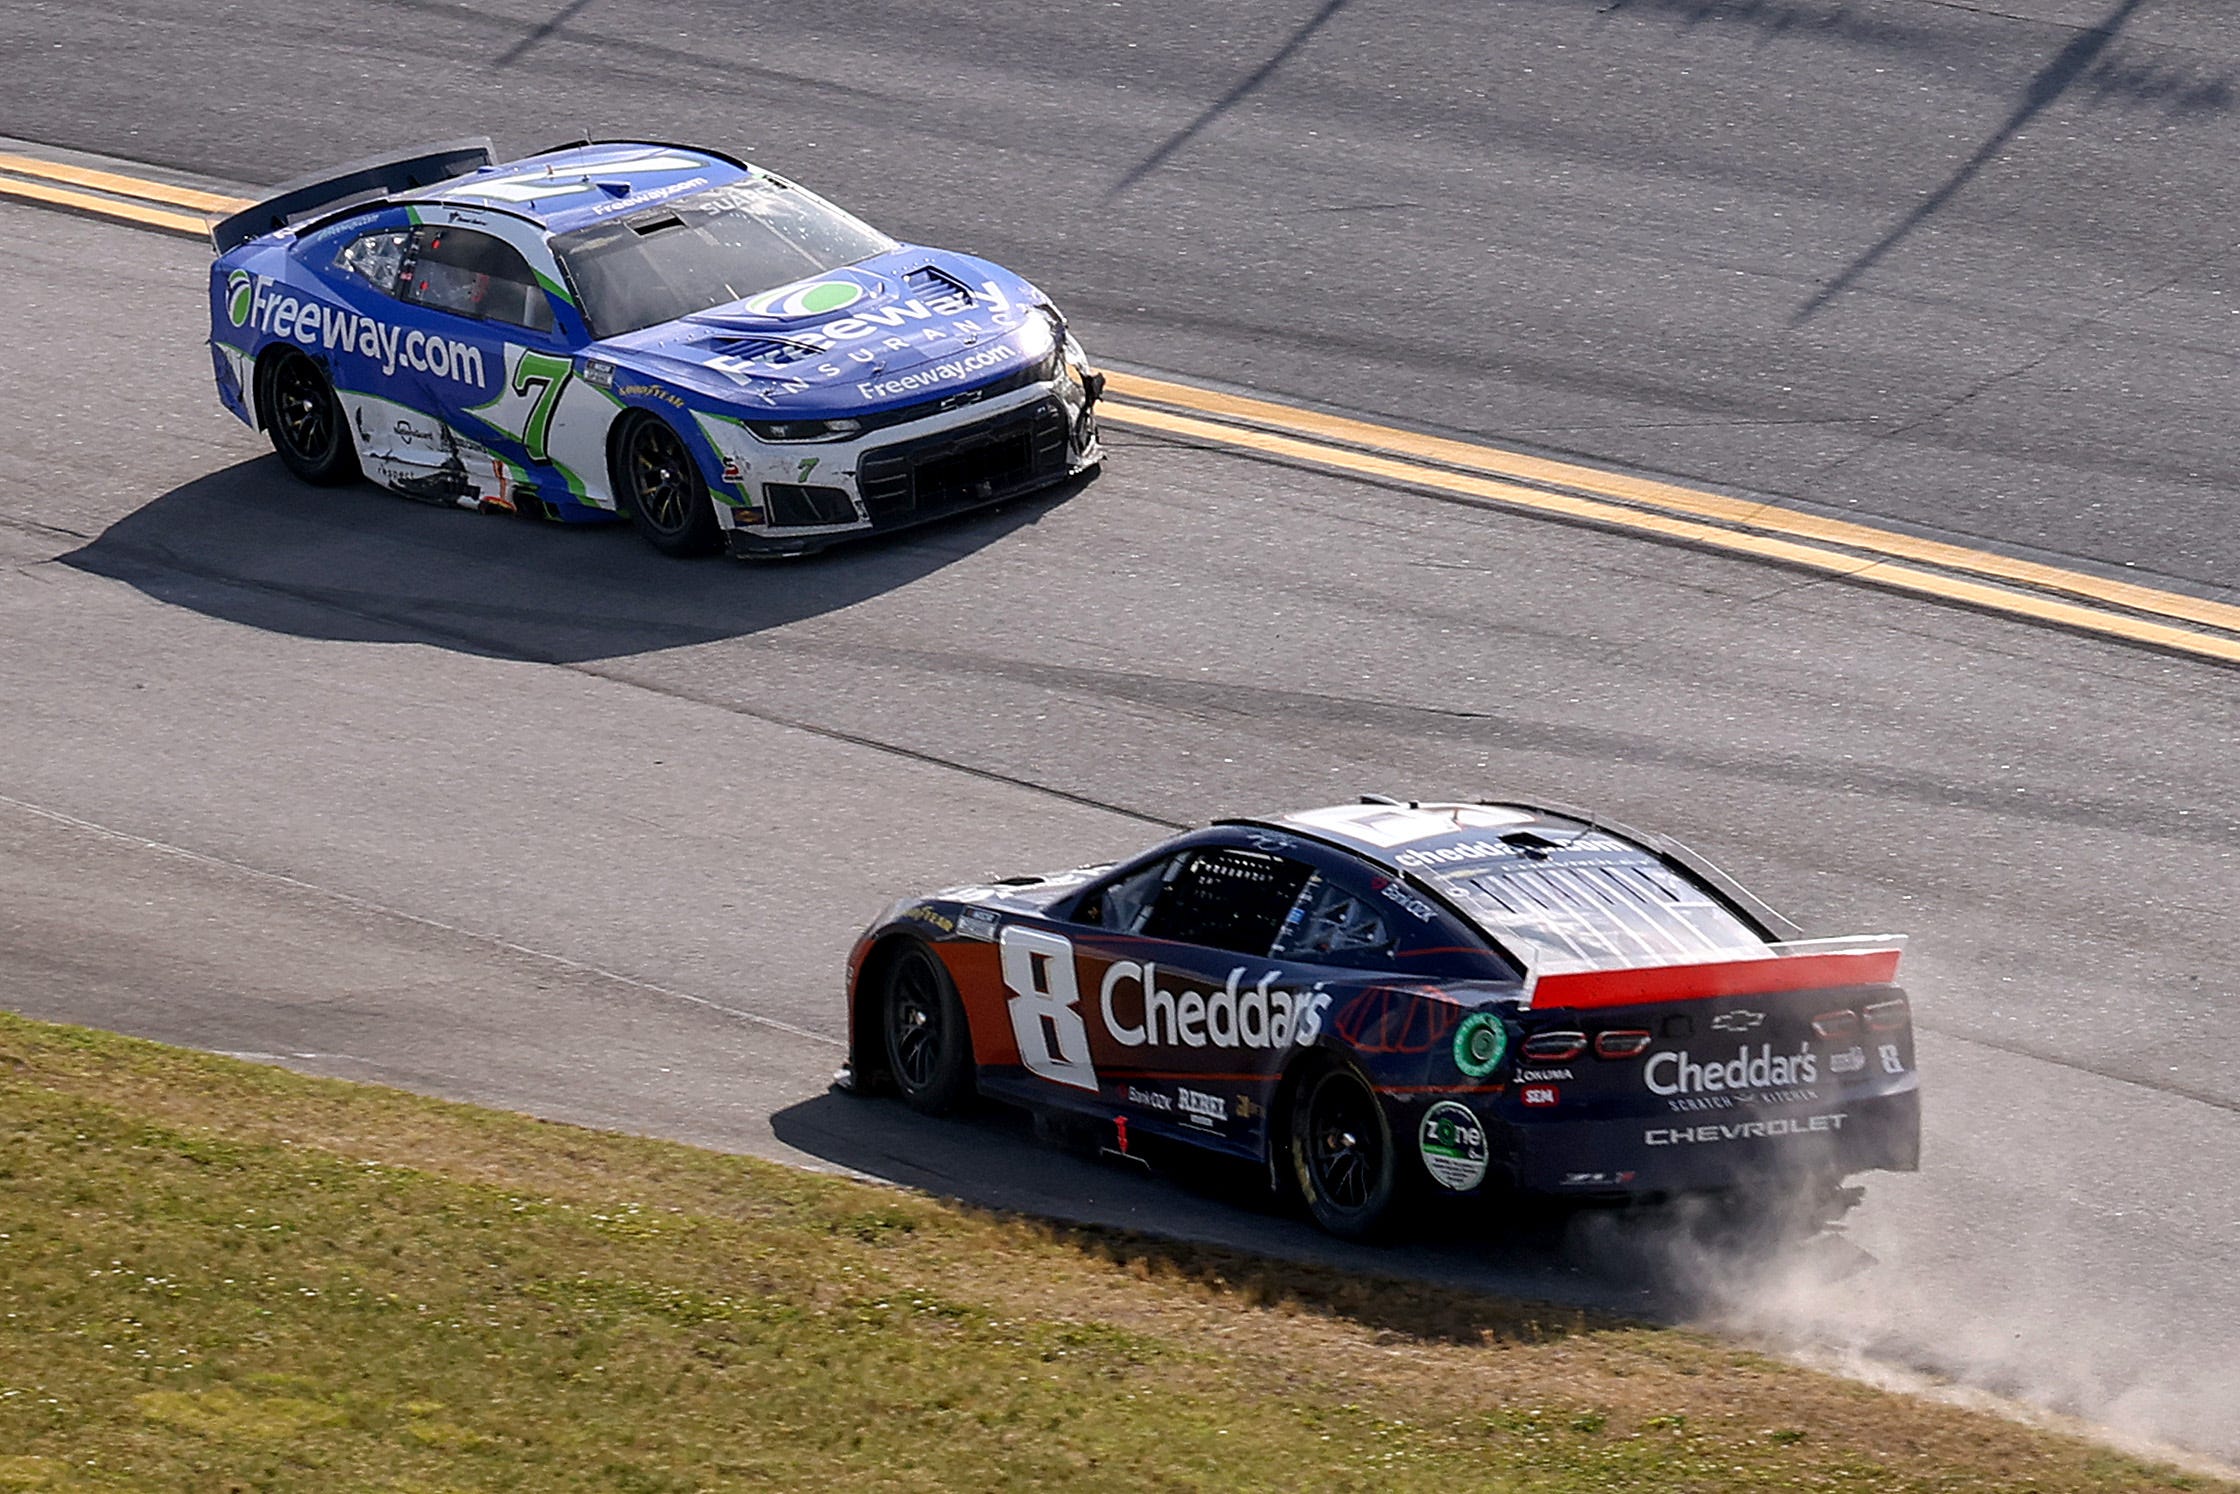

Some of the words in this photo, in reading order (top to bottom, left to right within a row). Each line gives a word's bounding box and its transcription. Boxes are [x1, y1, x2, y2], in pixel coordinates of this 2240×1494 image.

[591, 177, 709, 216] Freeway.com
[249, 273, 486, 389] Freeway.com
[856, 342, 1017, 401] Freeway.com
[512, 349, 575, 466] 7
[797, 457, 821, 484] 7
[1000, 924, 1100, 1092] 8
[1100, 960, 1335, 1049] Cheddar's
[1643, 1041, 1818, 1096] Cheddar's
[1878, 1044, 1905, 1074] 8
[1178, 1086, 1229, 1121] REBEL
[1668, 1096, 1734, 1113] SCRATCH
[1644, 1114, 1848, 1146] CHEVROLET
